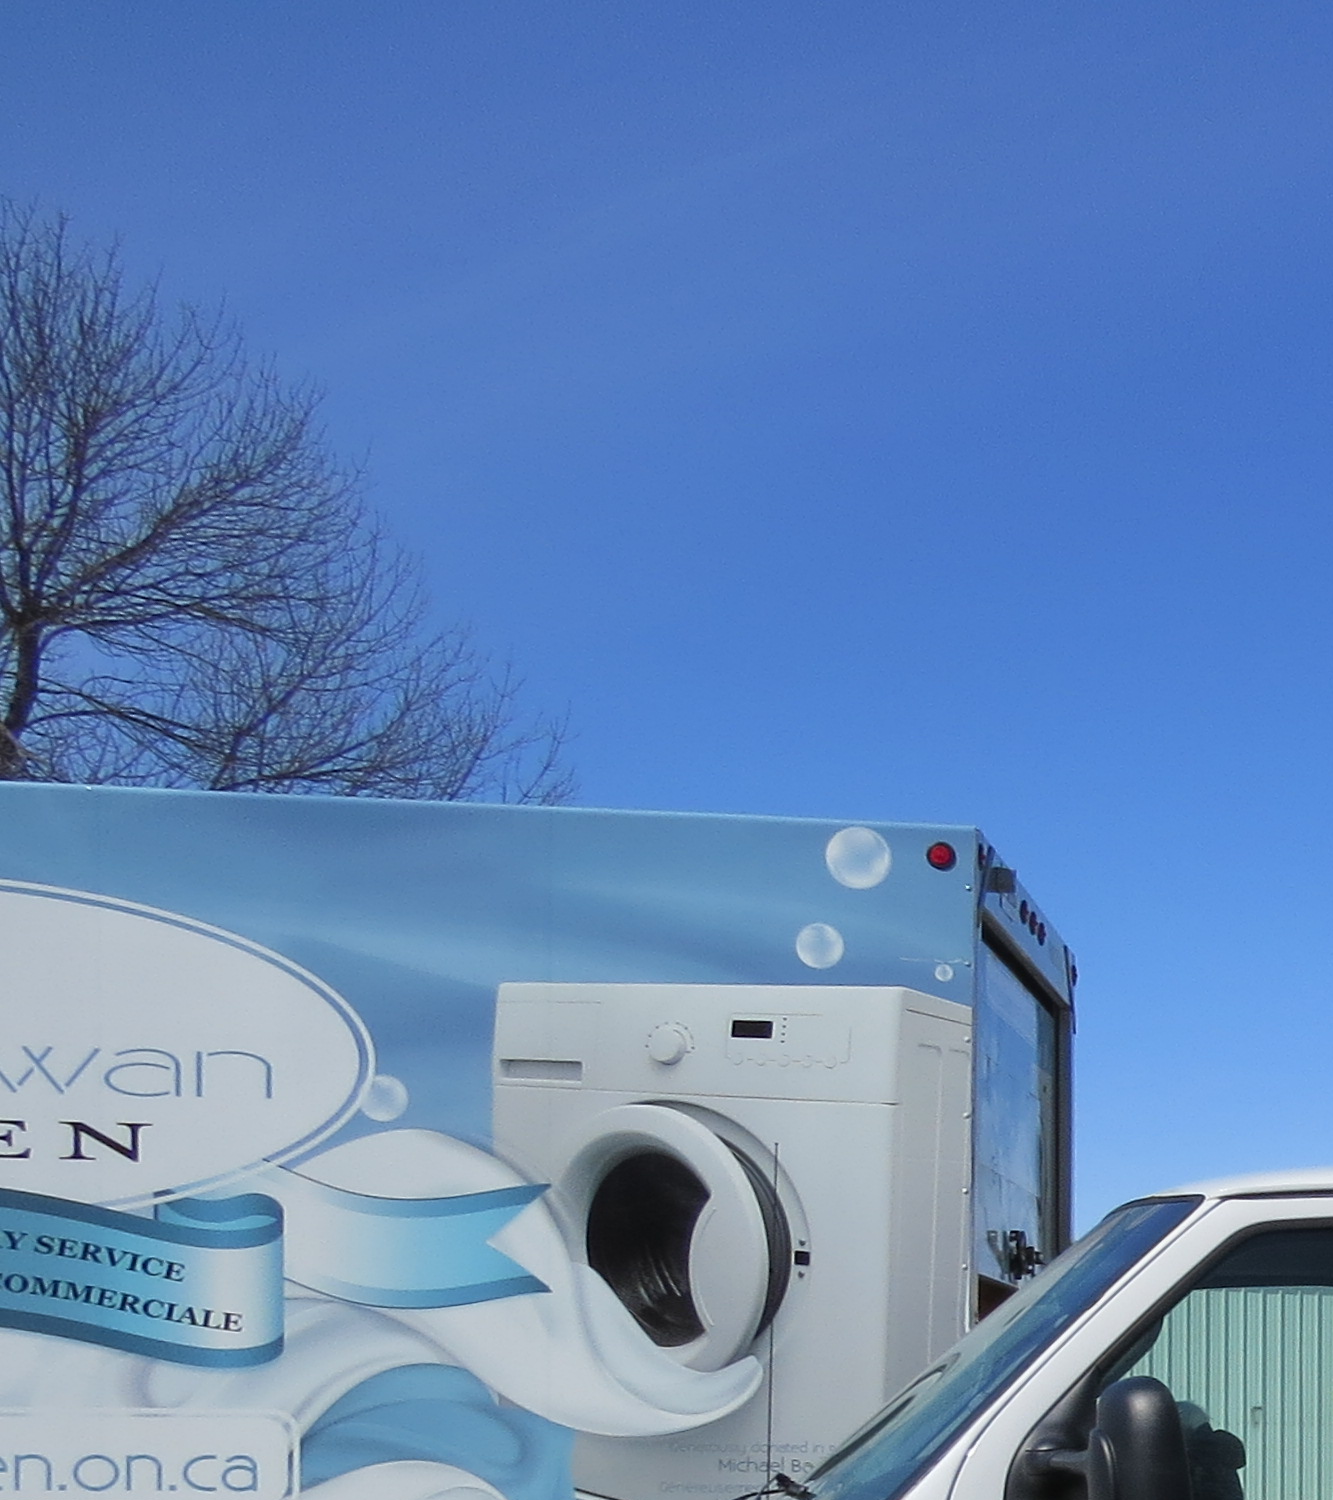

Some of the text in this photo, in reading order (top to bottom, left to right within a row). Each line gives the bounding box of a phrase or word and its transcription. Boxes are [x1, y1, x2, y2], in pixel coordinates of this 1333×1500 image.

[0, 1230, 187, 1283] Y SERVICE
[0, 1272, 244, 1333] OMMERCIALE
[718, 1456, 785, 1474] Michael
